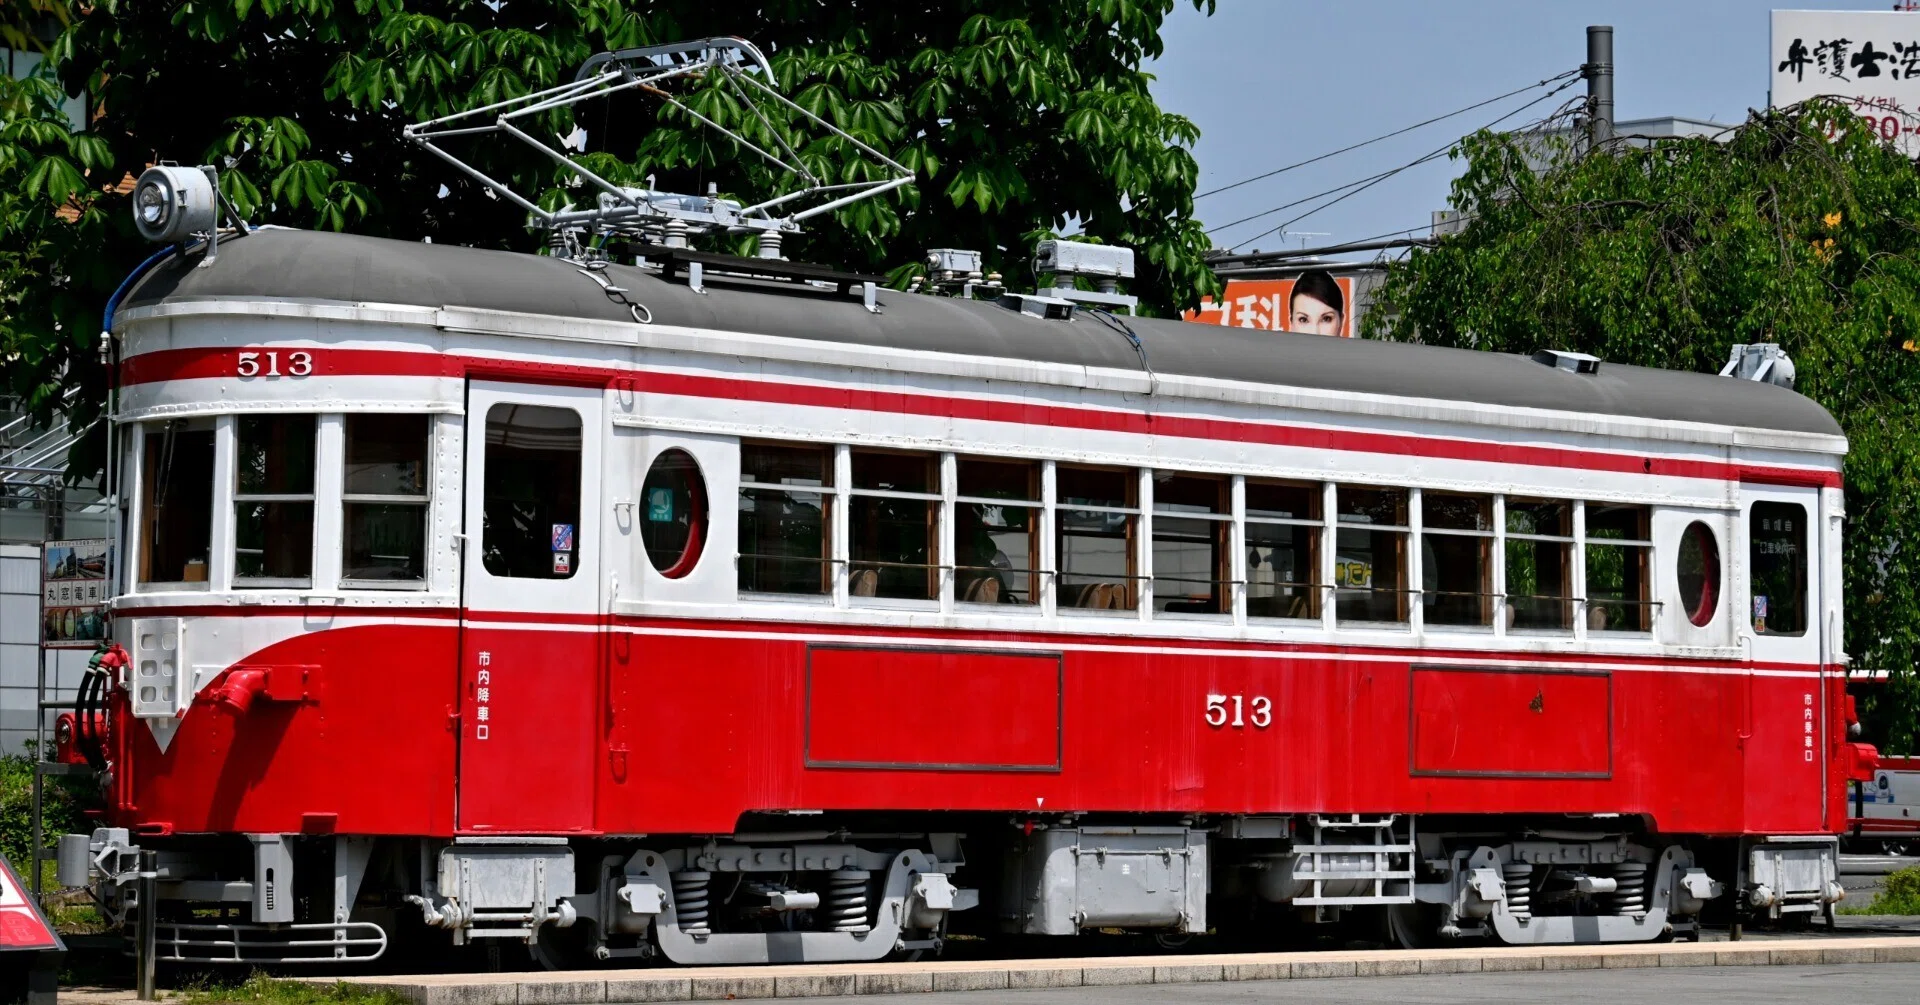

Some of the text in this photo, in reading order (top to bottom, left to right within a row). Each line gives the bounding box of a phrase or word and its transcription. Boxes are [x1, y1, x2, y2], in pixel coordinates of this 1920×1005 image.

[237, 351, 313, 376] 513
[47, 586, 106, 601] 丸窓電車
[477, 651, 491, 740] 市内降車口
[1205, 694, 1272, 727] 513
[1804, 693, 1813, 762] 市内乗車口
